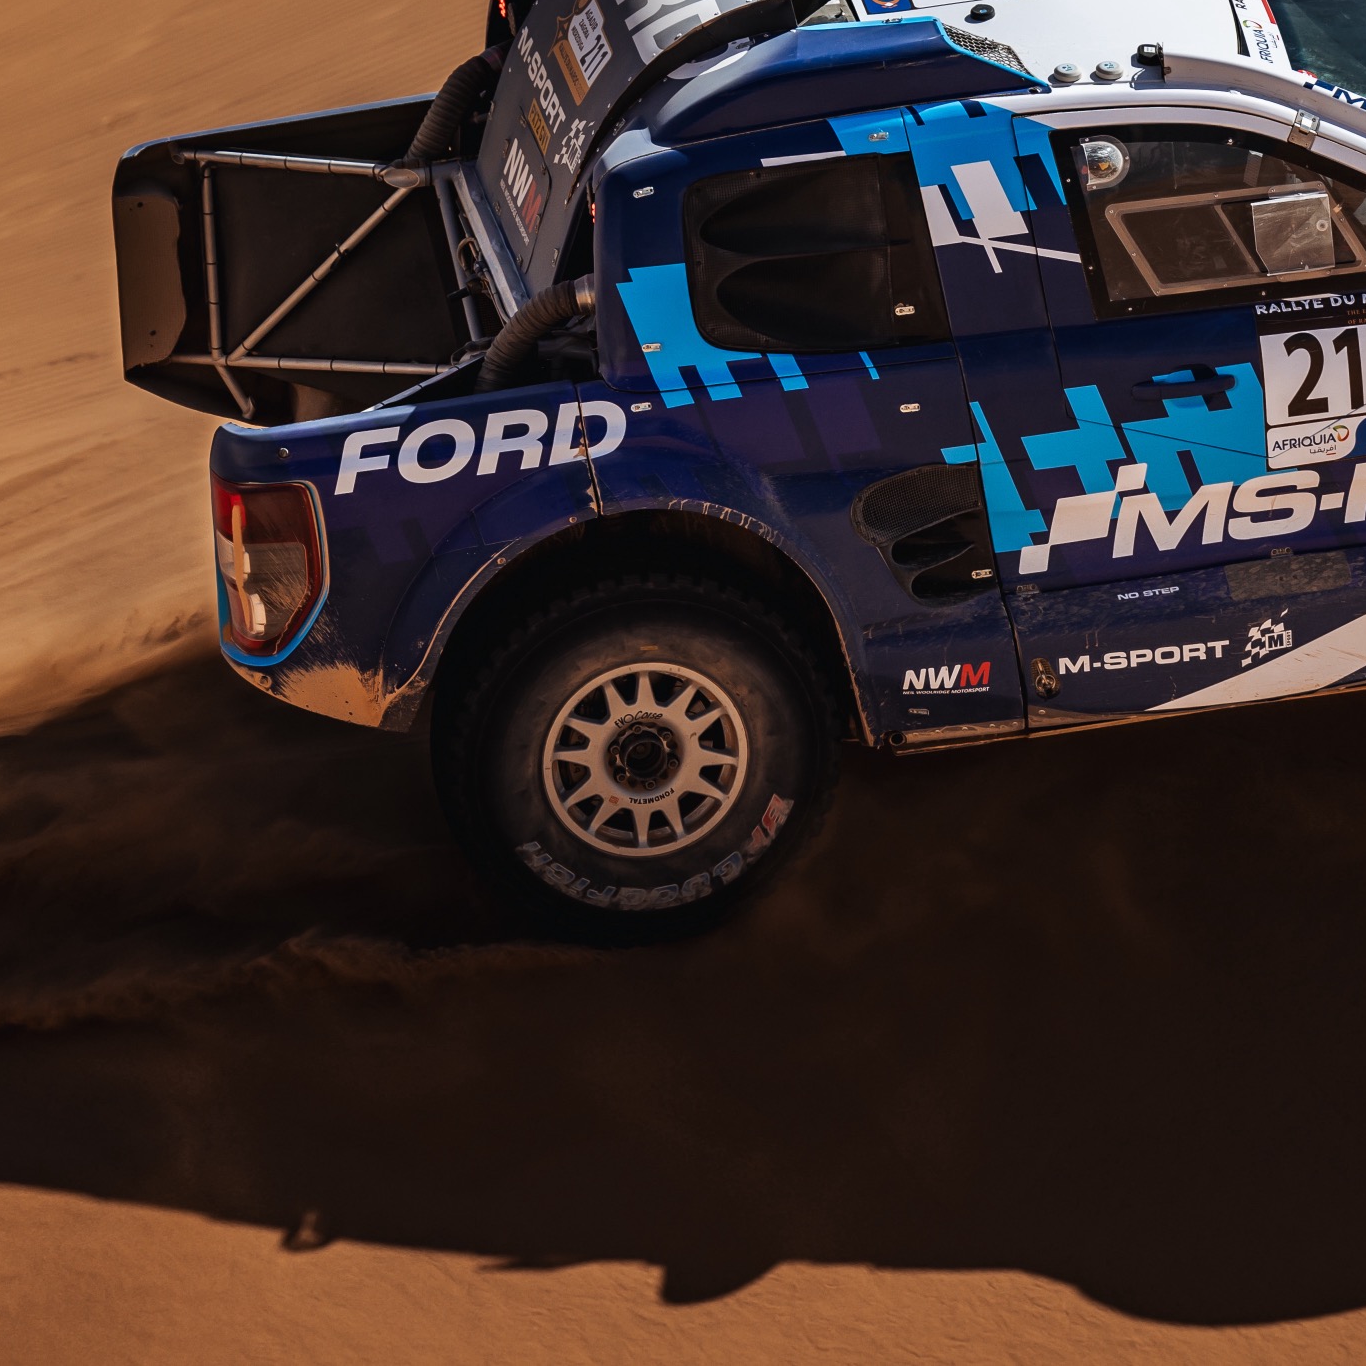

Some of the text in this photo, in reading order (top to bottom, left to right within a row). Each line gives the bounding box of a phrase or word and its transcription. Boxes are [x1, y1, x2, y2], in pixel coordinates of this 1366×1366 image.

[580, 34, 609, 81] 211
[517, 26, 566, 134] M-SPORT
[503, 138, 542, 233] NWM
[1255, 298, 1324, 315] RALLYE
[1330, 294, 1355, 307] DU
[334, 400, 627, 496] FORD
[1272, 435, 1337, 452] AFRIQUIA
[1117, 586, 1180, 601] NO STEP
[1058, 639, 1230, 675] M-SPORT
[903, 661, 991, 690] NWM
[629, 787, 675, 804] FONDMETAL
